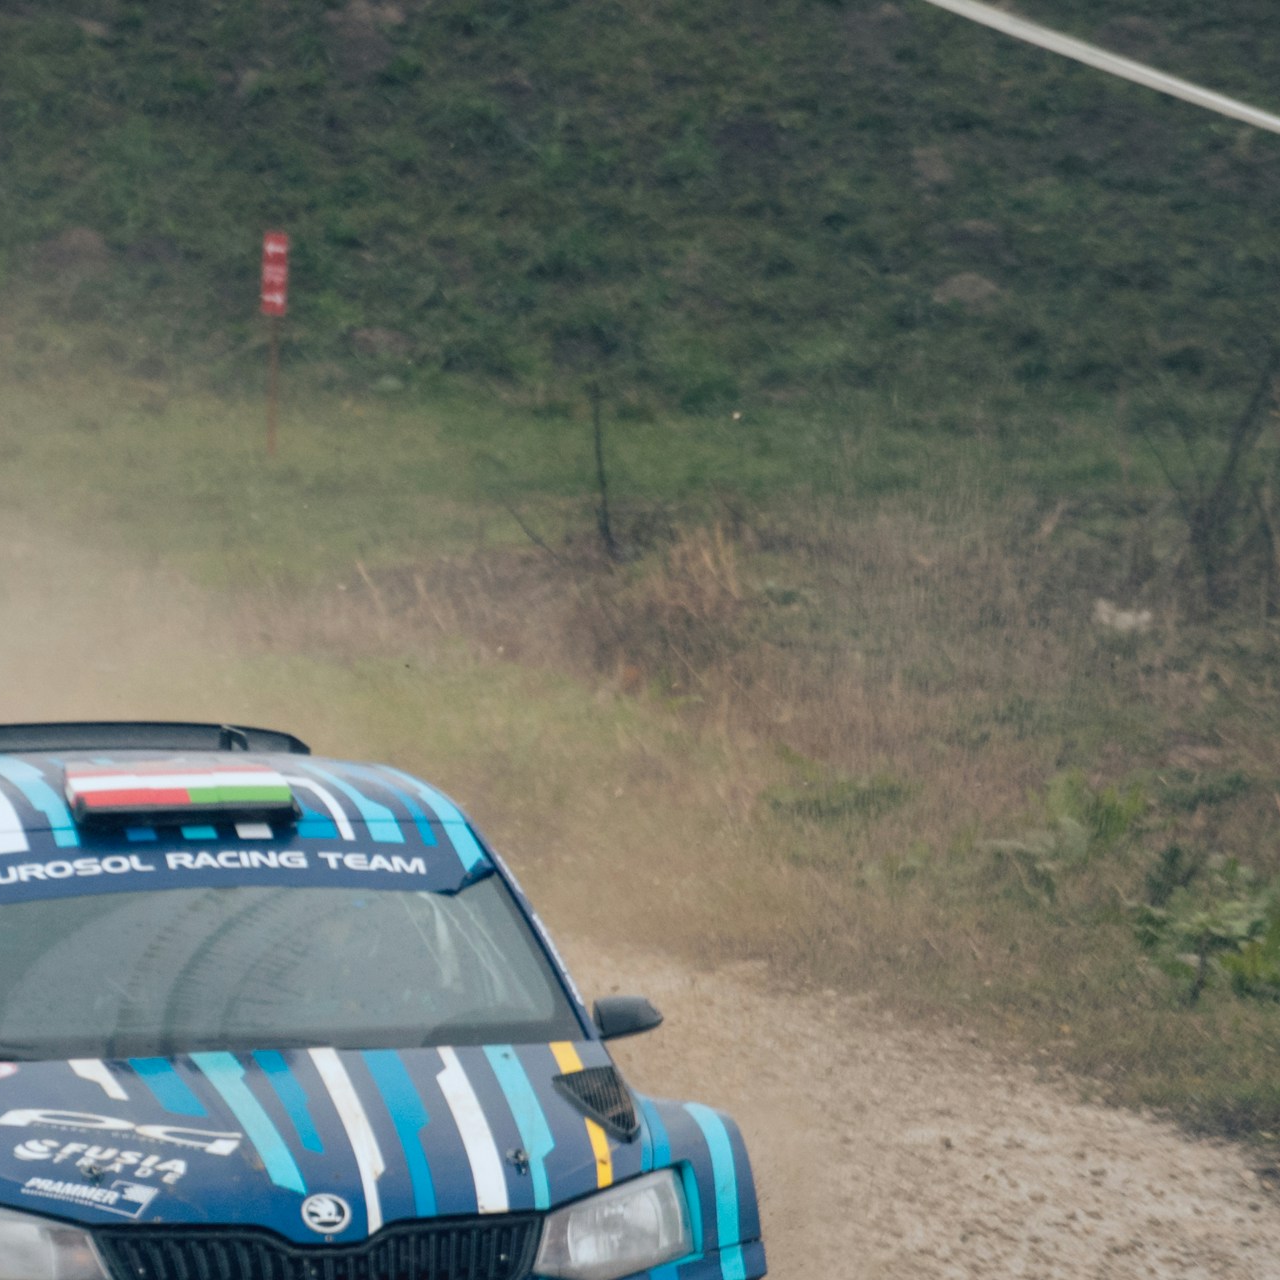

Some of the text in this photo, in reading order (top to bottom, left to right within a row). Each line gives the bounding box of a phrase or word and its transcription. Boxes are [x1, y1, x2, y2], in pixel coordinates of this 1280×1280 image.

[165, 850, 308, 870] RACING
[318, 851, 427, 876] TEAM
[56, 1141, 187, 1176] FUSIA
[24, 1177, 121, 1206] PRAMMER
